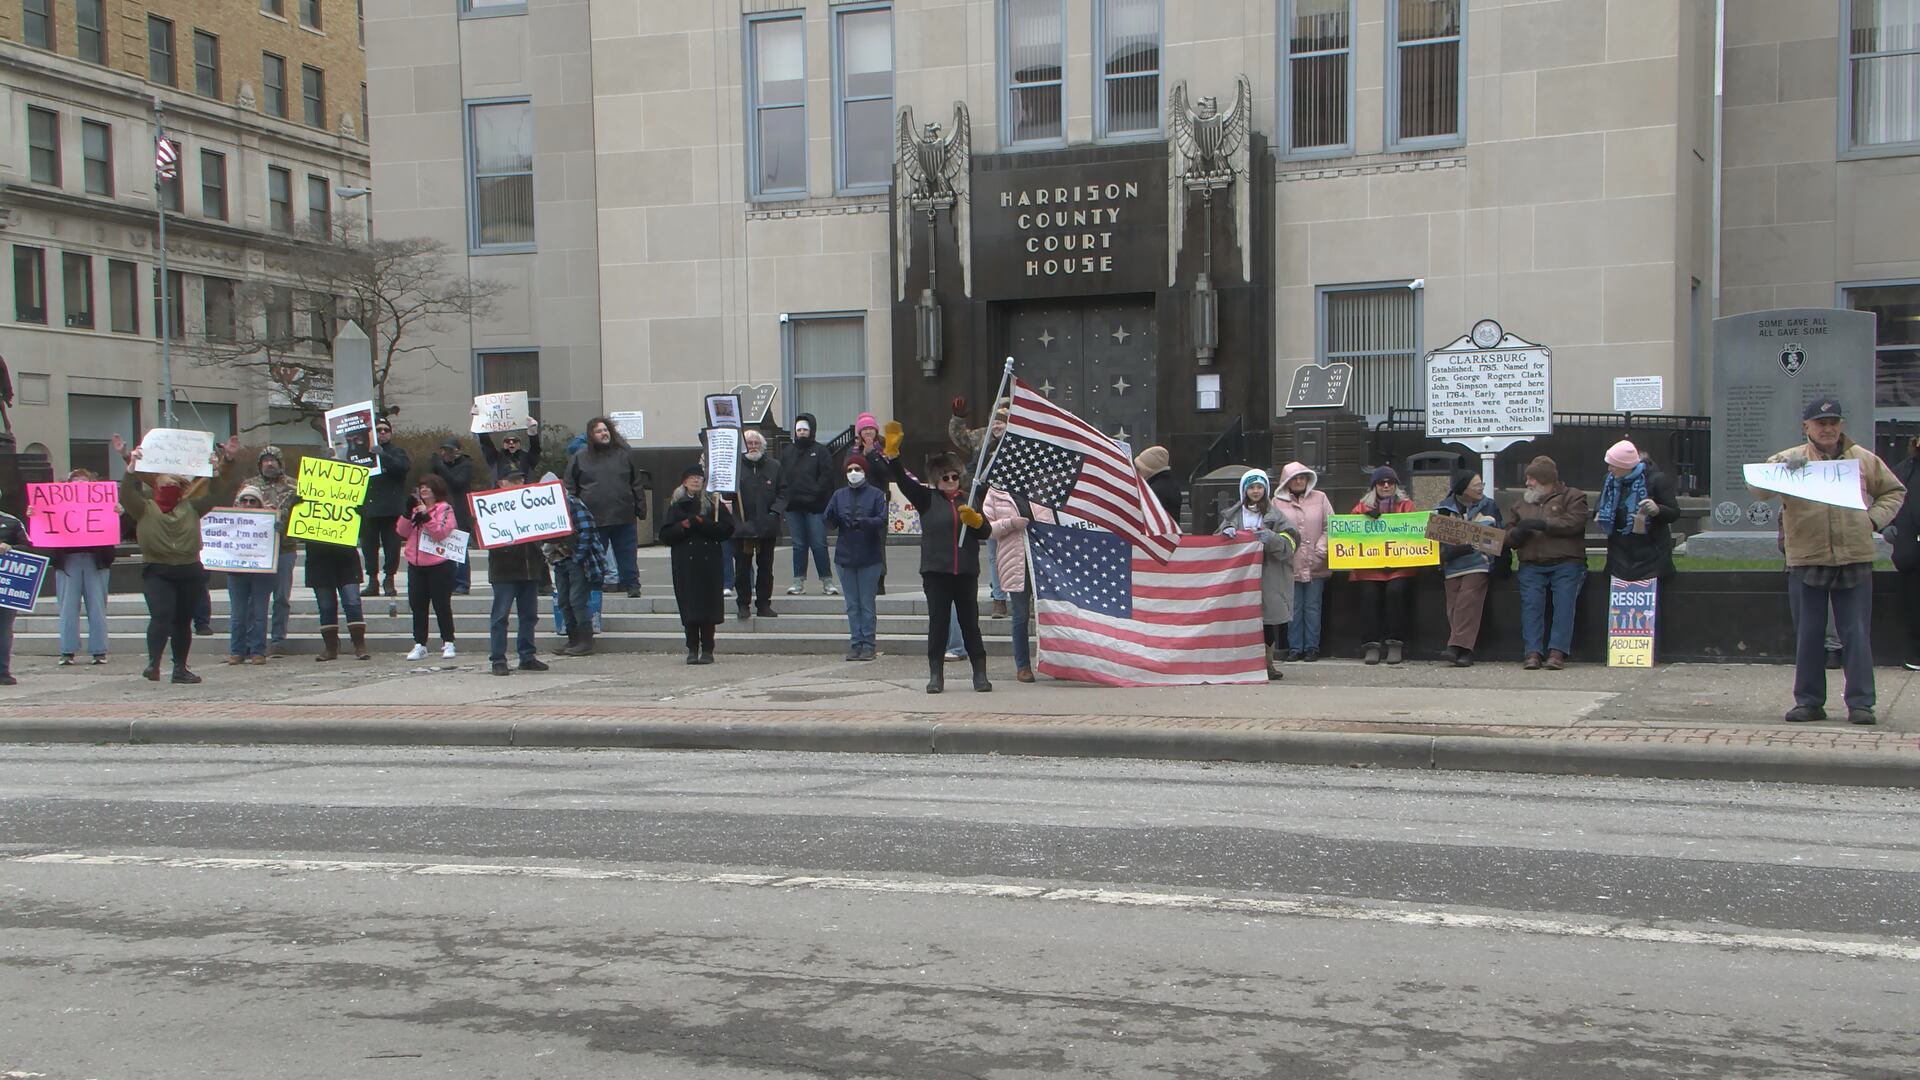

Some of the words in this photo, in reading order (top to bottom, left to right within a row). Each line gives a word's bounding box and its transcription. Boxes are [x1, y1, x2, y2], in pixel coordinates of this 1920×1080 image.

[1000, 182, 1138, 207] HARRISON
[1018, 207, 1120, 229] COUNTY
[1026, 232, 1112, 252] COURT
[1026, 256, 1112, 276] HOUSE
[1758, 320, 1783, 328] SOME
[1787, 319, 1808, 327] GAVE
[1759, 329, 1773, 337] ALL
[1777, 328, 1799, 336] GAVE
[1803, 327, 1828, 335] SOME
[1449, 353, 1527, 364] CLARKSBURG
[1453, 374, 1480, 383] George
[1487, 373, 1515, 381] Rogers
[1456, 383, 1488, 391] Simpson
[1494, 381, 1522, 389] camped
[485, 394, 512, 404] LOVE
[1475, 391, 1496, 399] Early
[1503, 390, 1544, 398] permanent
[1535, 397, 1545, 406] by
[485, 409, 513, 420] HATE
[303, 460, 369, 486] WWJD?
[1824, 463, 1851, 483] UP
[33, 483, 116, 506] ABOLISH
[299, 482, 325, 497] Who
[331, 486, 359, 502] Would
[476, 498, 517, 518] Renee
[521, 486, 556, 510] Good
[299, 500, 356, 522] JESUS
[42, 509, 104, 534] ICE
[294, 520, 347, 538] Detain?
[489, 522, 514, 540] Say
[514, 519, 531, 533] her
[1331, 521, 1361, 533] RENEE
[1365, 520, 1387, 533] GOOD
[1430, 516, 1482, 534] CORRUPTION
[236, 530, 250, 538] I'm
[1438, 527, 1467, 538] GREED
[1472, 534, 1480, 543] IS
[1335, 543, 1355, 557] But
[1359, 543, 1364, 557] I
[1366, 549, 1380, 557] am
[1385, 541, 1433, 557] Furious!
[0, 558, 38, 577] UMP
[8, 588, 30, 600] Rolls
[1611, 592, 1656, 606] RESIST!
[1610, 639, 1650, 650] ABOLISH
[1618, 654, 1645, 665] ICE
